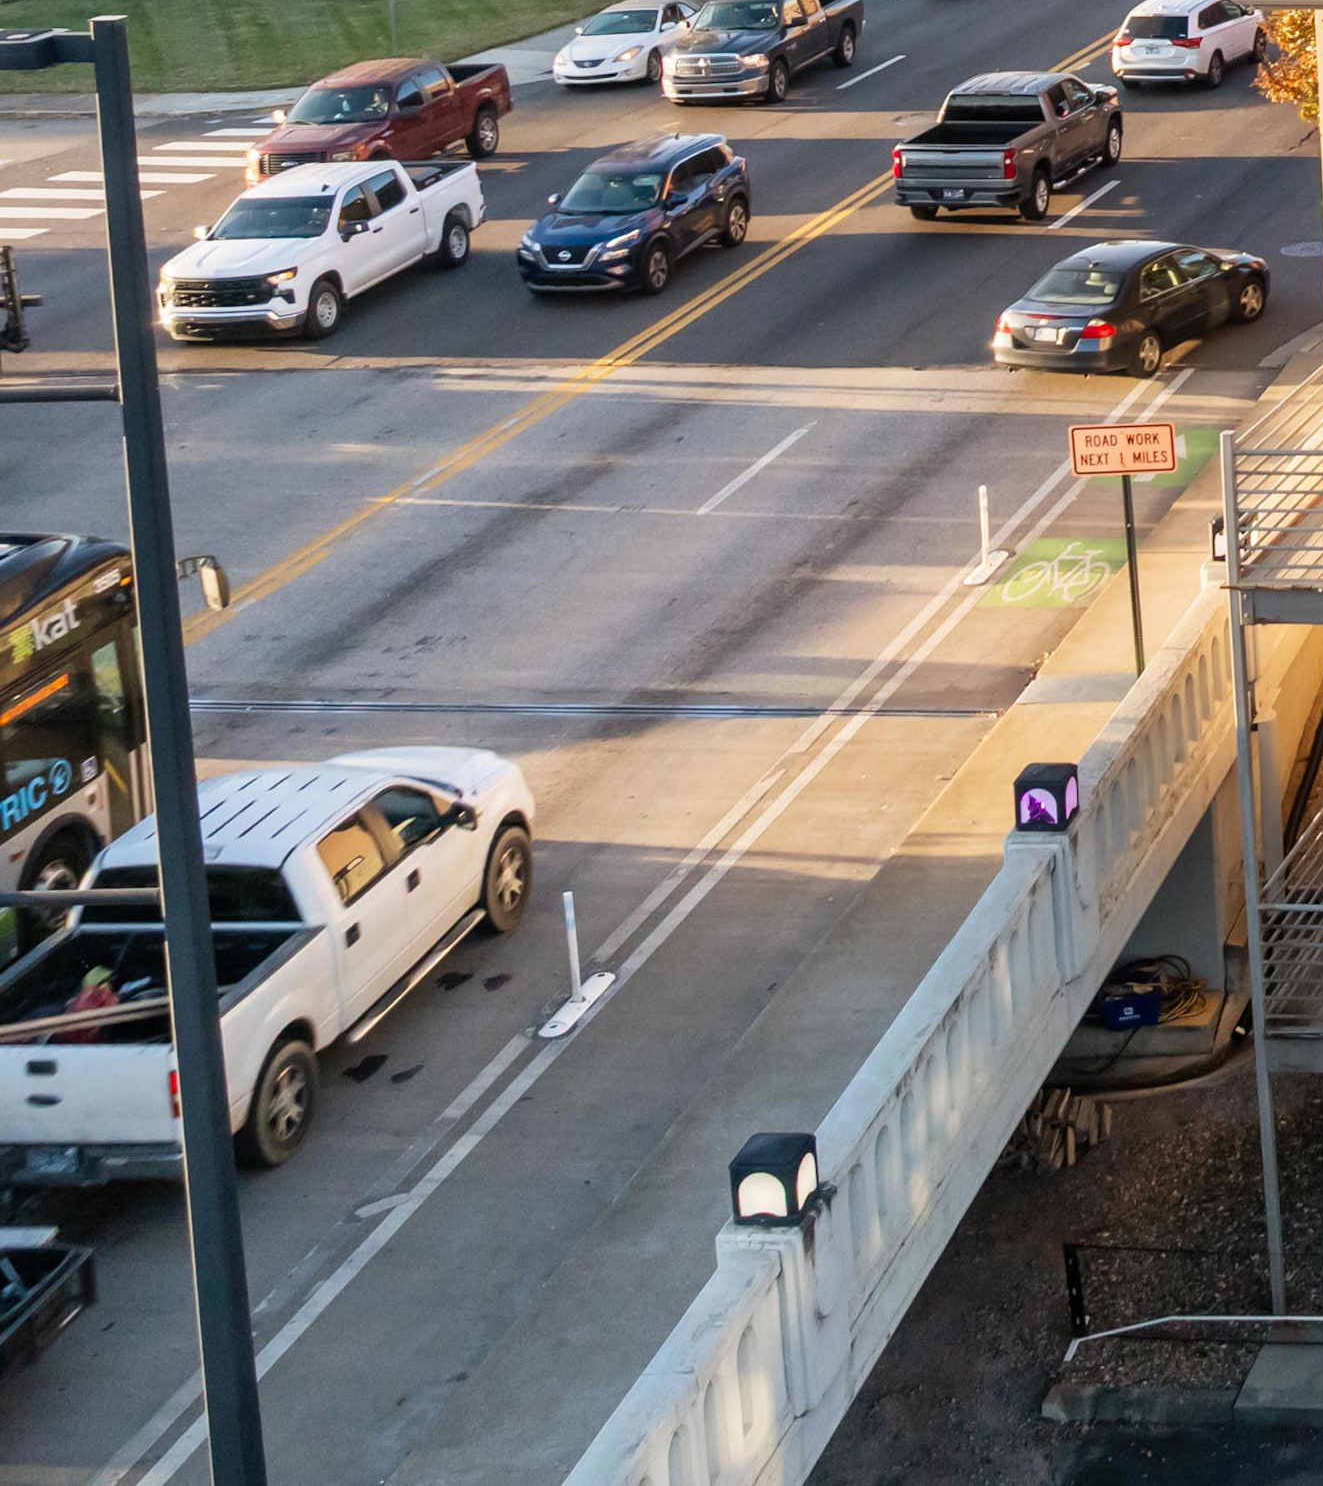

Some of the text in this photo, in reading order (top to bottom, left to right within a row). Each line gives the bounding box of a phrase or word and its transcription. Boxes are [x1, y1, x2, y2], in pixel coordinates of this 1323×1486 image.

[1085, 433, 1160, 447] ROAD WORK
[1080, 453, 1109, 466] NEXT
[1133, 451, 1168, 463] MILES
[31, 598, 80, 651] kat
